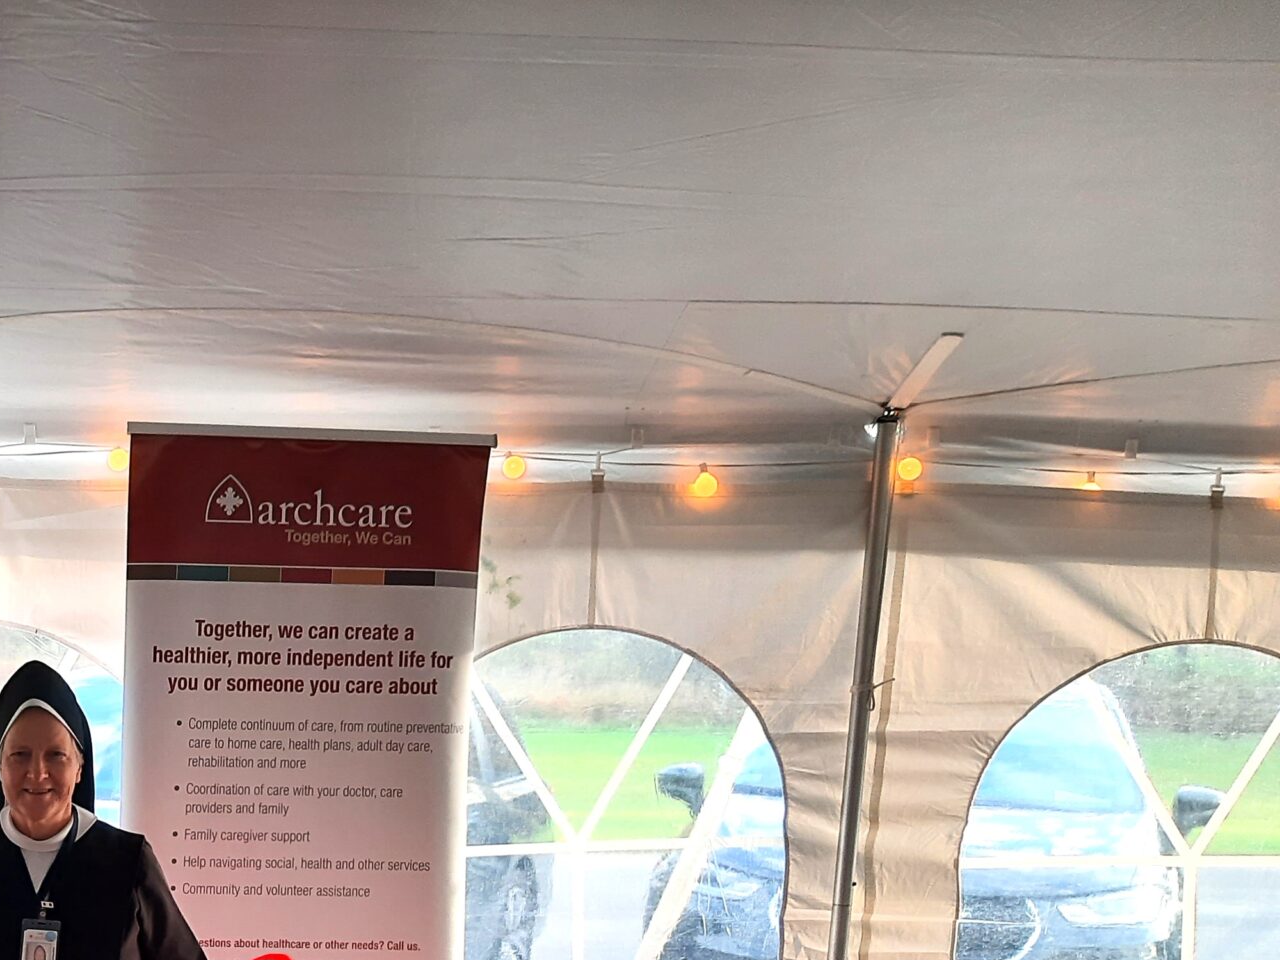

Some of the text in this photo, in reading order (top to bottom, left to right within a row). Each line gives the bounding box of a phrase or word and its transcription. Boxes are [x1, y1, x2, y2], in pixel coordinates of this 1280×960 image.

[259, 489, 412, 528] archcare
[285, 529, 411, 546] Together, We Can
[195, 620, 414, 641] Together, we can create a
[153, 646, 453, 670] healthier, more independent life for
[168, 677, 437, 696] you or someone you care about
